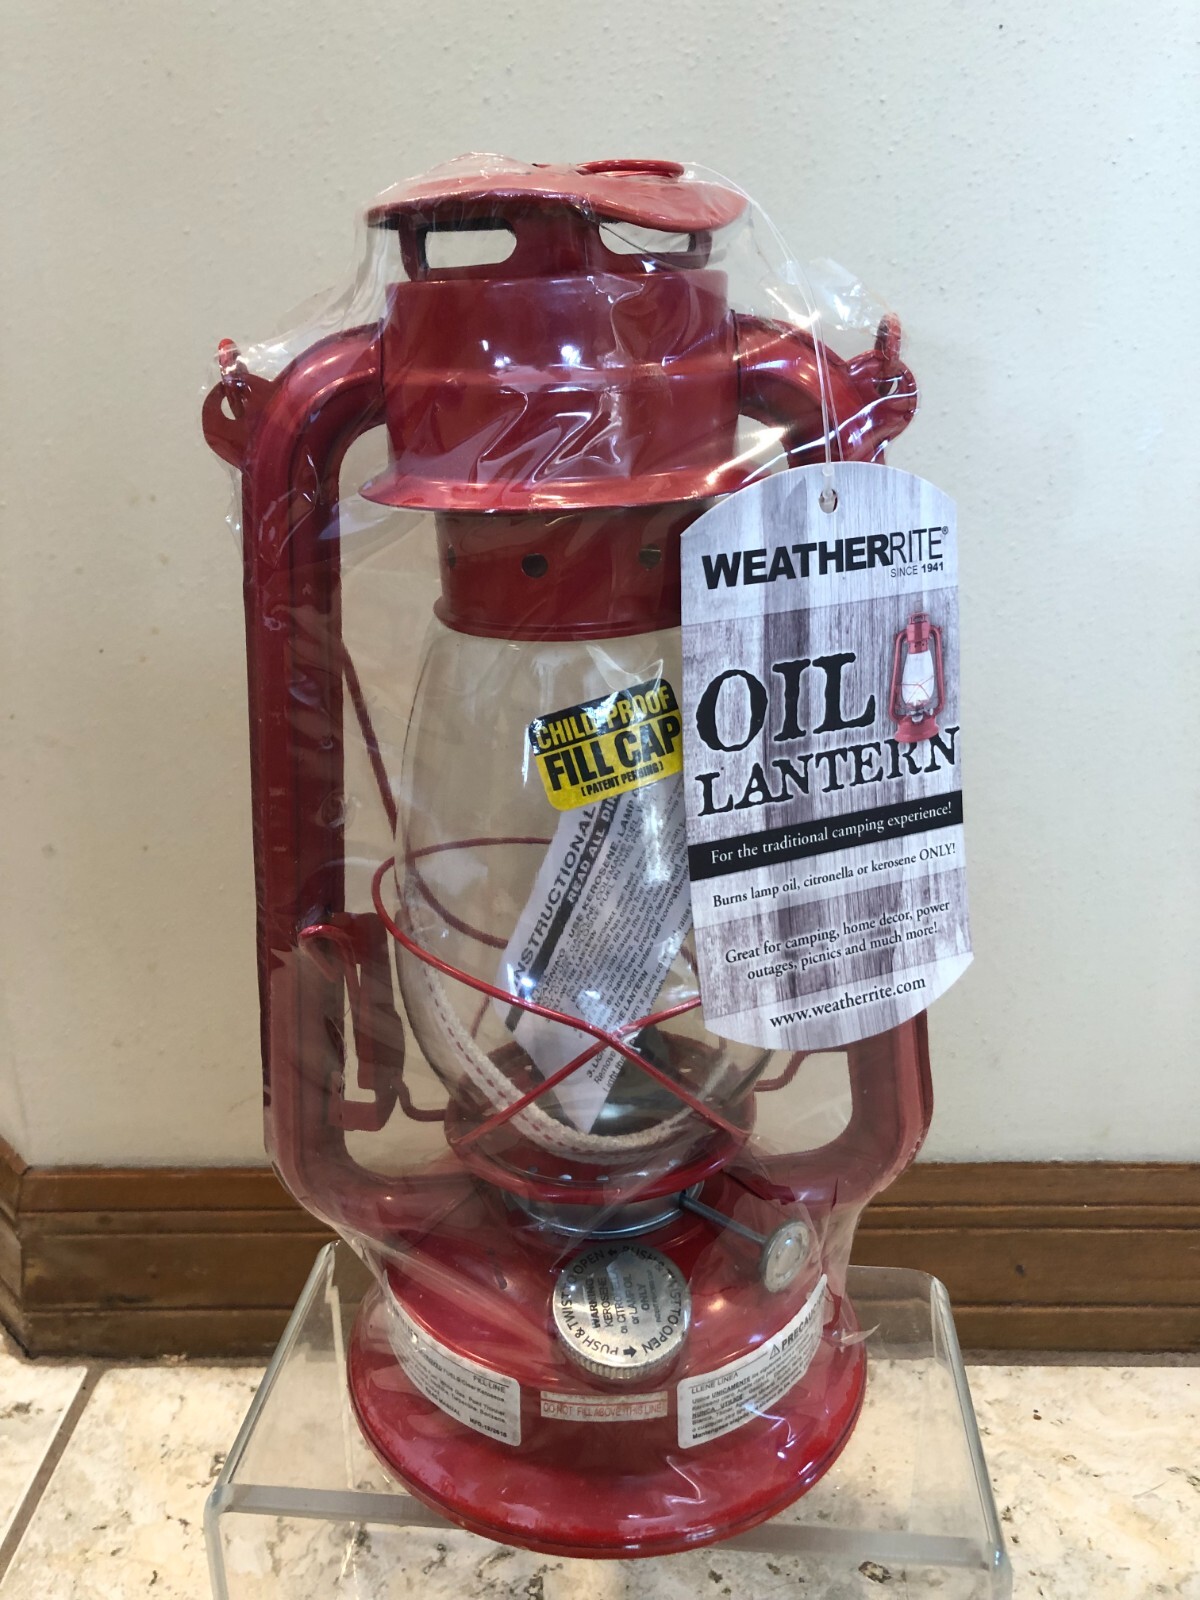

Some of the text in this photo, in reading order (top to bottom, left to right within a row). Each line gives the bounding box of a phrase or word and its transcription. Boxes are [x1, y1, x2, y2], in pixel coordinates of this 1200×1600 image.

[890, 562, 944, 578] SINCE 1941
[696, 652, 875, 752] OIL
[544, 716, 680, 791] FILL CAP
[695, 727, 959, 816] LANTERN
[587, 774, 620, 795] PATENT
[711, 803, 952, 864] For the traditional camping experience!
[567, 858, 590, 903] READ
[587, 826, 605, 858] ALL
[713, 843, 956, 907] Burns lamp oil, citronella or kerosene ONLY!
[653, 881, 672, 915] cleaned
[568, 911, 583, 938] USE
[725, 902, 950, 963] Great for camping, home decor, power
[592, 932, 611, 965] product
[747, 922, 938, 980] outages, picnics and much more!
[614, 968, 638, 1008] transport
[623, 968, 648, 1011] LANTERN
[770, 978, 926, 1028] www.weatherrite.com
[593, 1049, 615, 1084] Remove
[642, 973, 658, 998] glass
[573, 1251, 605, 1276] OPEN
[561, 1292, 579, 1331] TWIST
[598, 1277, 613, 1328] KEROSENE
[637, 1284, 650, 1311] ONLY
[574, 1327, 586, 1339] &
[582, 1334, 619, 1356] PUSH
[642, 1324, 674, 1356] OPEN
